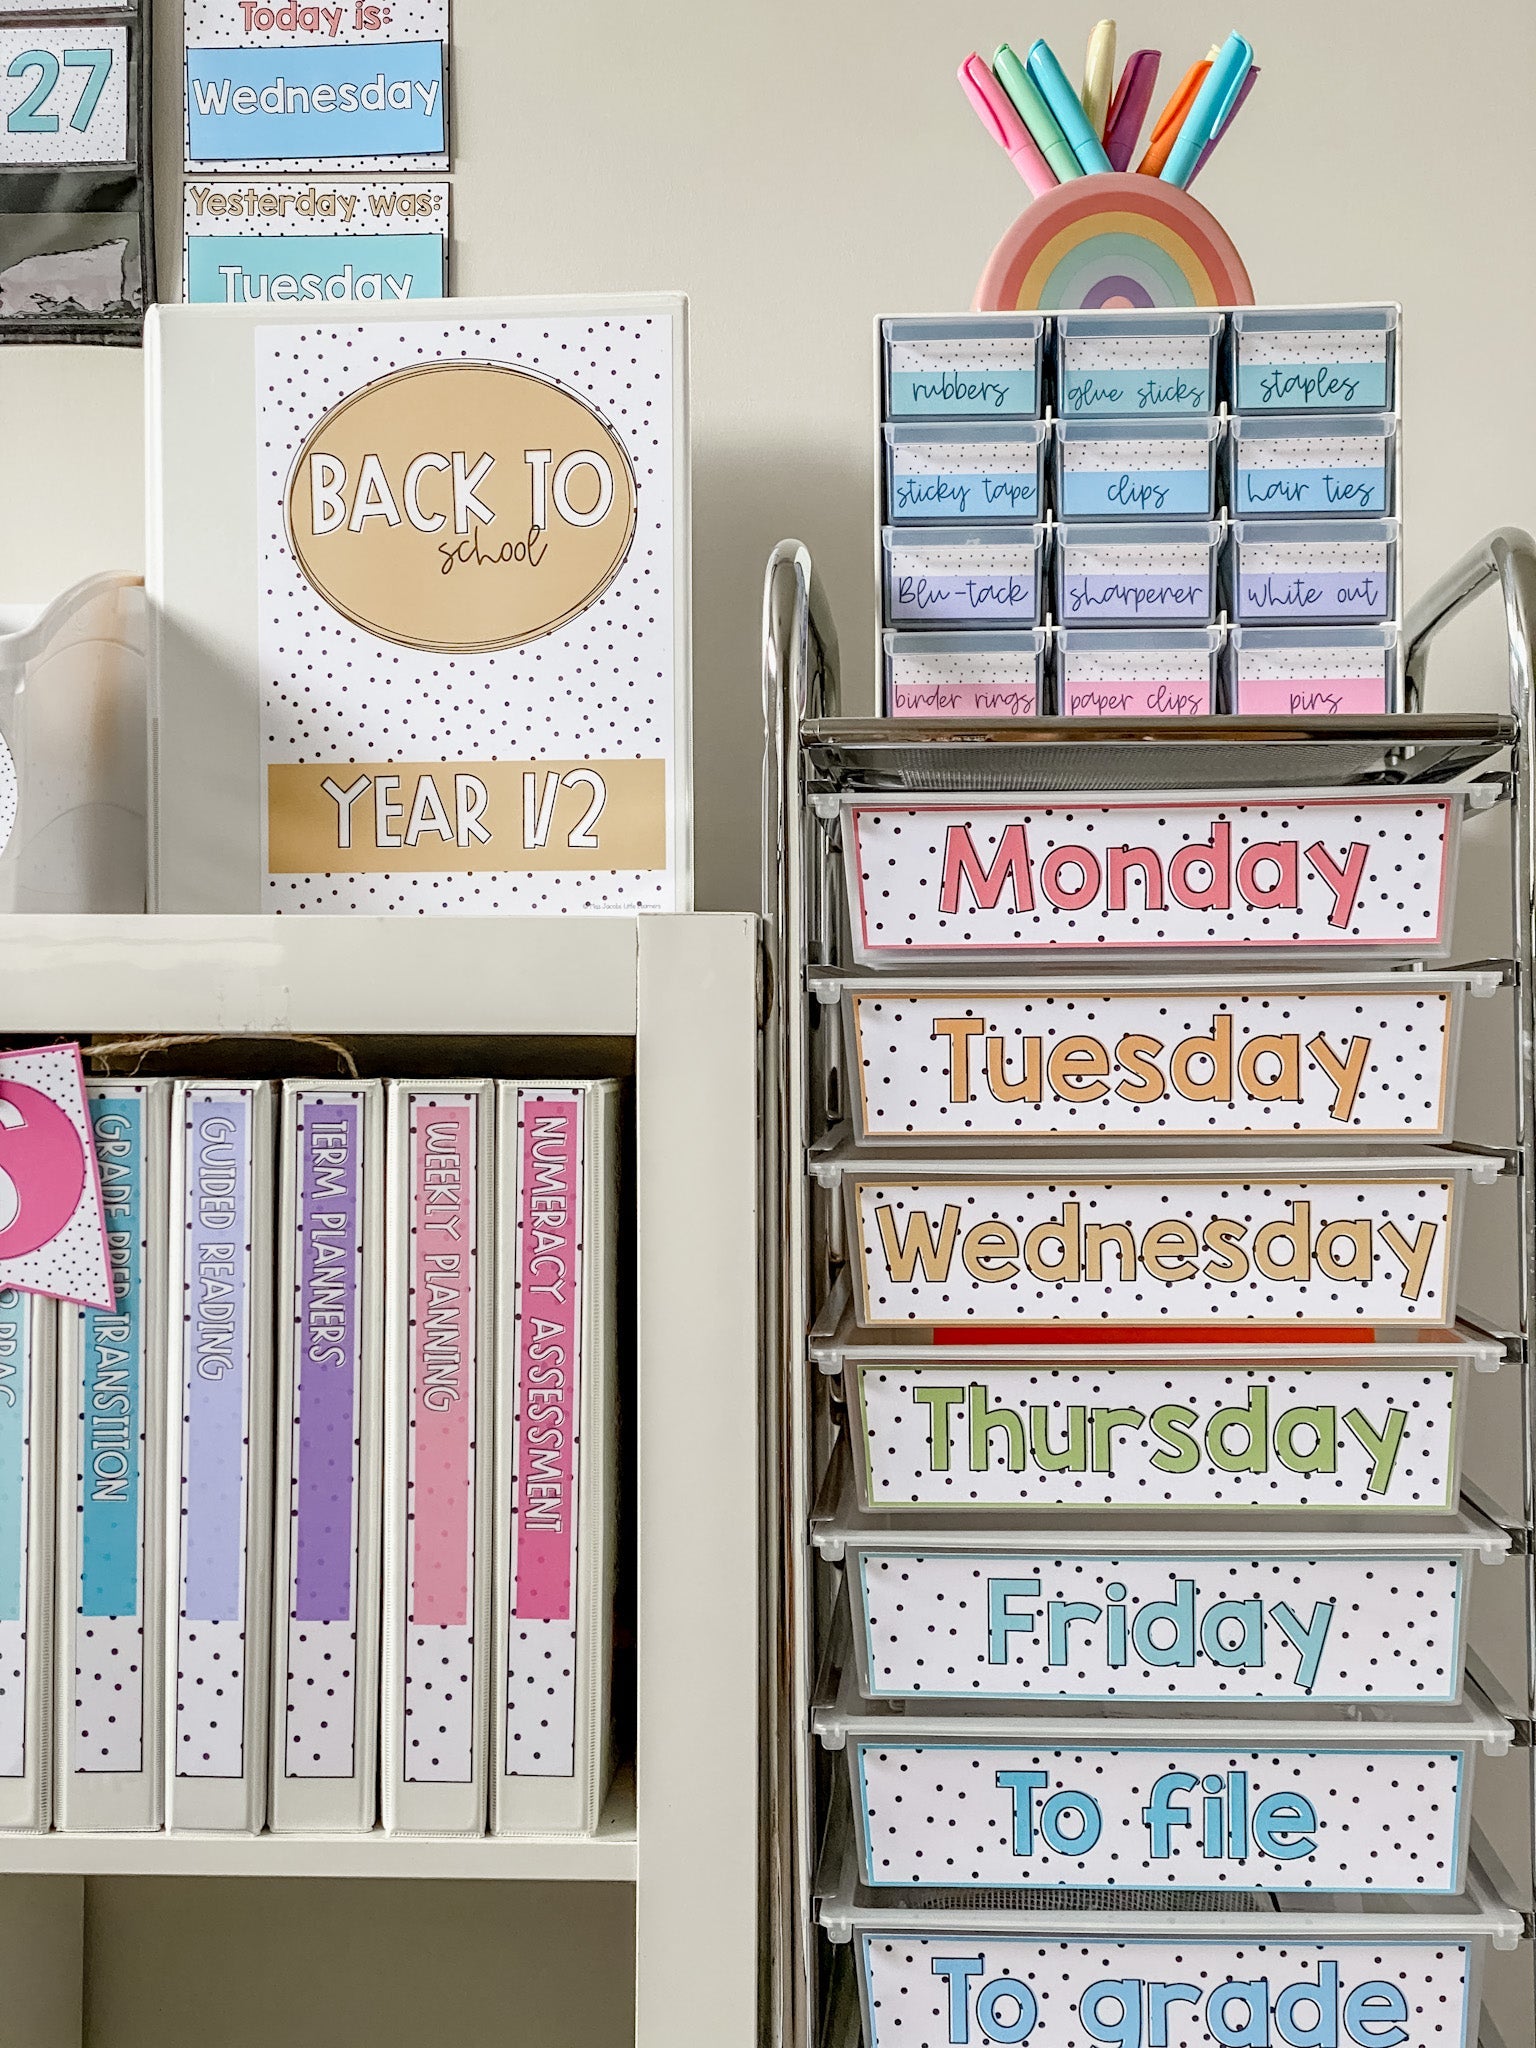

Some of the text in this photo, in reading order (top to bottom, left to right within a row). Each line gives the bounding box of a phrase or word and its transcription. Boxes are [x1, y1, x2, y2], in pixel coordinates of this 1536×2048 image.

[240, 1, 390, 37] Today is:
[7, 49, 113, 133] 27
[192, 74, 439, 117] Wednesday
[190, 188, 441, 222] Yesterday was:
[219, 265, 413, 302] Tuesday
[912, 372, 1010, 407] rubbers
[1067, 376, 1205, 409] glue sticks
[1260, 368, 1359, 400] staples
[310, 450, 614, 535] BACK TO
[897, 476, 1036, 512] sticky tape
[1107, 475, 1169, 509] clips
[1248, 474, 1374, 507] hair ties
[438, 524, 548, 574] school
[898, 577, 1028, 607] Blu-tack
[1070, 577, 1202, 610] sharpener
[1248, 578, 1378, 606] white out
[895, 683, 1035, 715] binder rings
[1070, 683, 1203, 715] paper clips
[1290, 688, 1343, 715] pins
[321, 773, 492, 849] YEAR
[938, 821, 1369, 930] Monday
[932, 1015, 1371, 1123] Tuesday
[196, 1116, 237, 1382] GUIDED READING
[307, 1119, 347, 1368] TERM PLANNERS
[875, 1201, 1438, 1302] Wednesday
[423, 1121, 461, 1413] WEEKLY PLANNING
[524, 1116, 568, 1534] NUMERACY ASSESSMENT
[91, 1313, 132, 1504] TRANSITION
[913, 1385, 1408, 1495] Thursday
[987, 1578, 1335, 1688] Friday
[996, 1769, 1319, 1860] To file
[932, 1958, 1409, 2048] To grade
